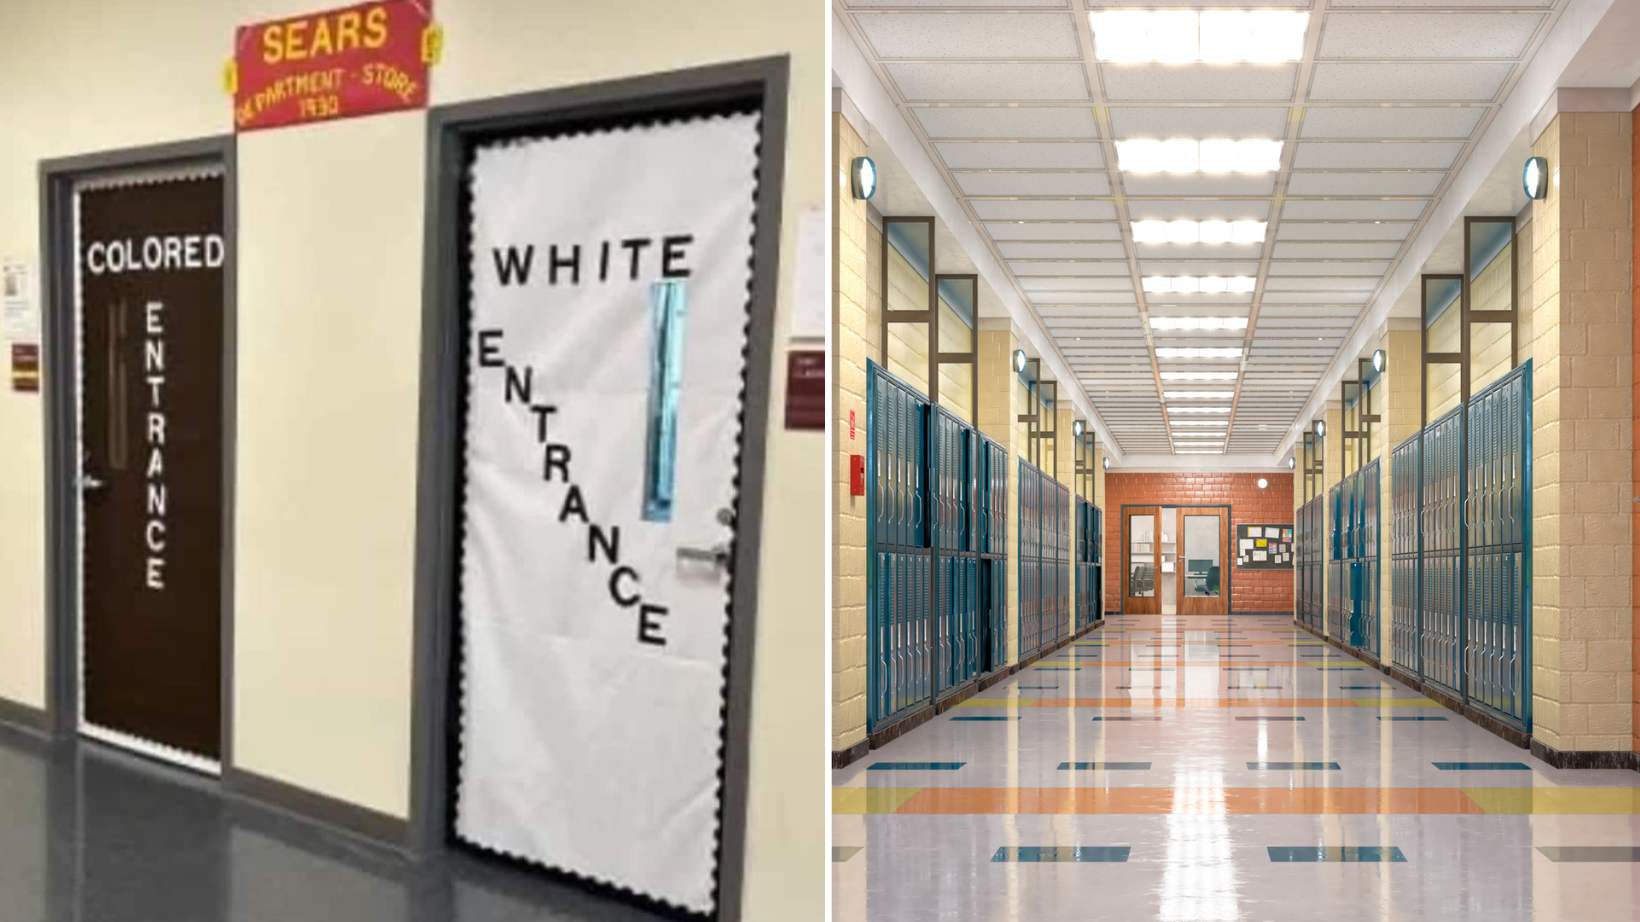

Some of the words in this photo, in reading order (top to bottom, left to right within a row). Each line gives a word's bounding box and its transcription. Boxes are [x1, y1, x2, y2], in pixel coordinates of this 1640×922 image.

[263, 7, 387, 63] SEARS
[238, 69, 345, 125] DEPARTMENT
[362, 63, 417, 103] STORE
[299, 96, 339, 117] 1930
[87, 234, 224, 274] COLORED
[493, 235, 694, 286] WHITE
[145, 302, 166, 588] ENTRANCE
[478, 330, 668, 645] ENTRANCE
